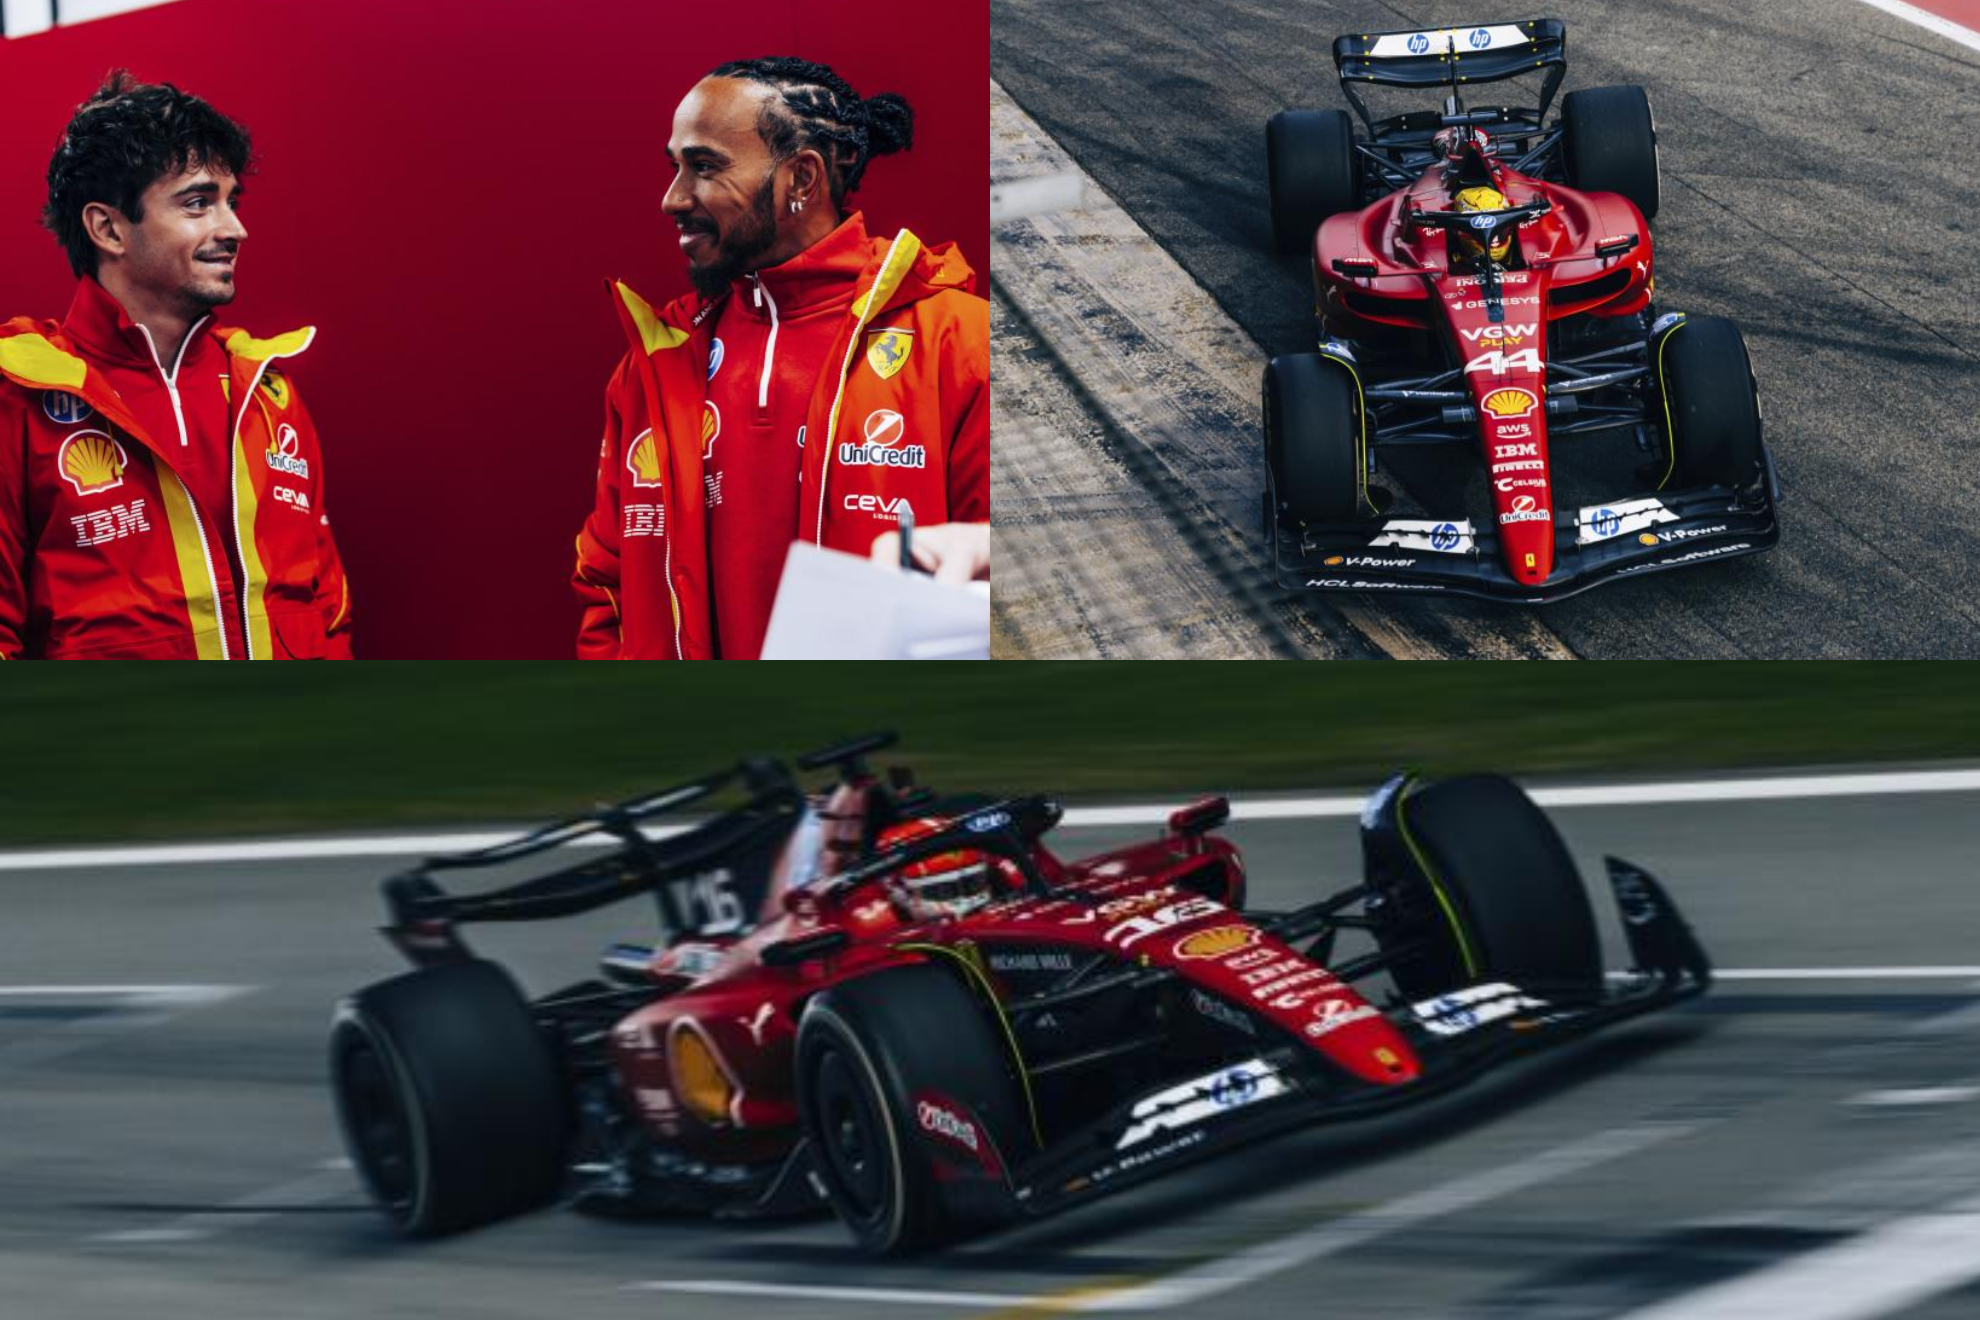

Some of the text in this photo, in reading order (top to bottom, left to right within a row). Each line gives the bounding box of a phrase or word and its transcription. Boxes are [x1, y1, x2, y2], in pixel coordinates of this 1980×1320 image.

[1409, 34, 1428, 54] hp
[1471, 29, 1490, 48] hp
[1471, 215, 1495, 228] hp
[1460, 323, 1537, 341] VGW
[1464, 348, 1545, 375] 44
[1496, 423, 1530, 435] aws
[840, 443, 926, 468] UniCredit
[1494, 443, 1537, 458] IBM
[70, 498, 151, 548] IBM
[872, 513, 898, 521] LOGIS
[1657, 524, 1728, 542] V-Power
[1346, 556, 1416, 567] V-Power
